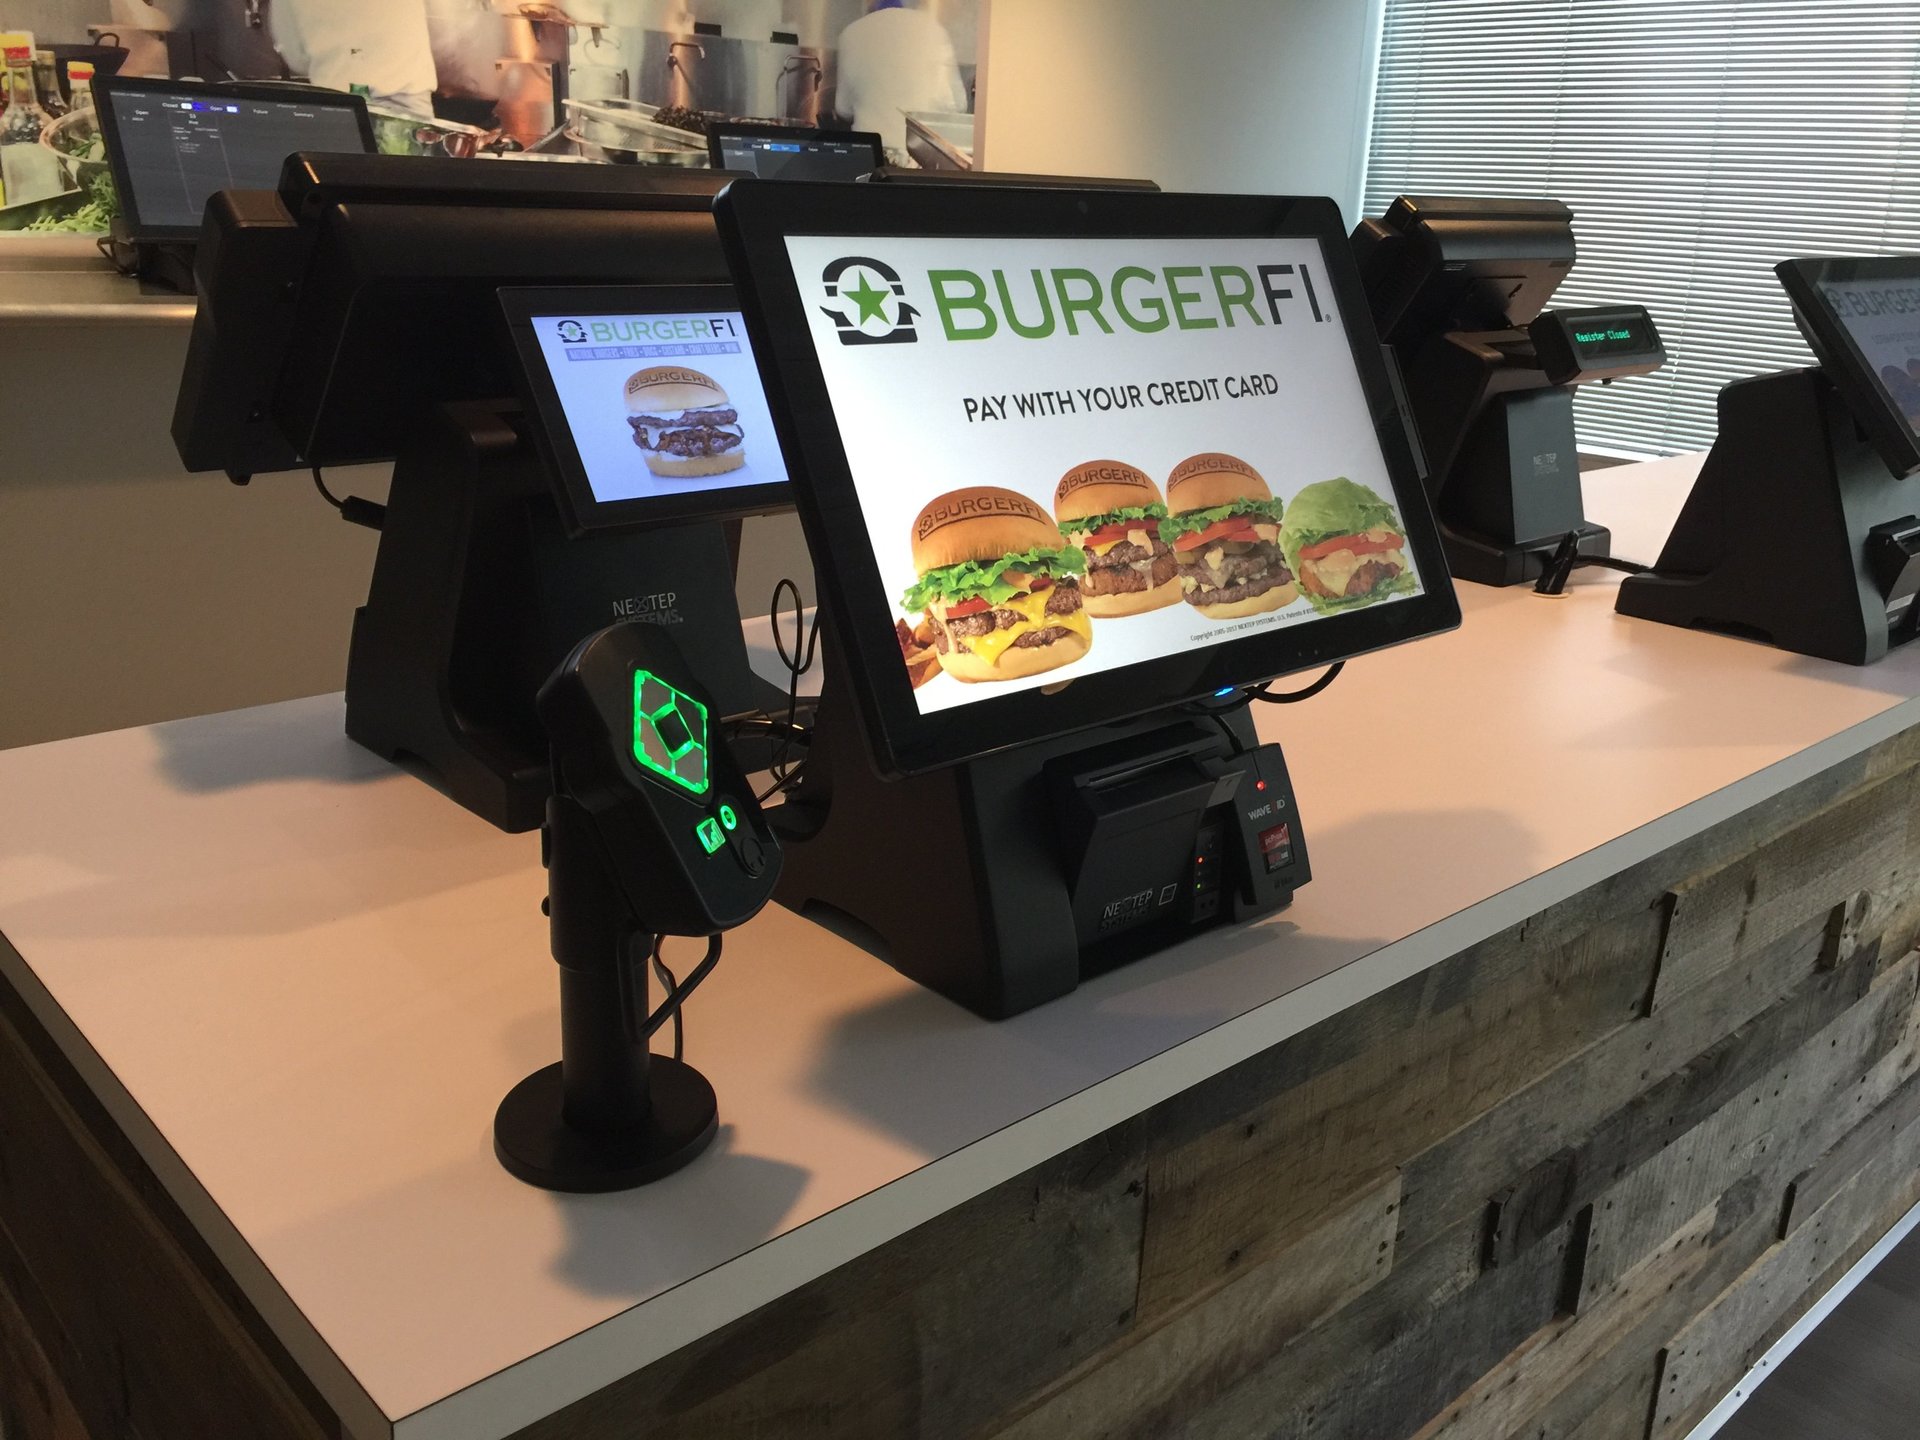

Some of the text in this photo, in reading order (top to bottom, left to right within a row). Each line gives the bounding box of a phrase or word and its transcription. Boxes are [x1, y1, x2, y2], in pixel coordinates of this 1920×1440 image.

[927, 263, 1324, 341] BURGERFI
[591, 318, 736, 342] BURGERFI
[1575, 329, 1630, 342] Register Closed
[963, 373, 1279, 423] PAY WITH YOUR CREDIT CARD
[1068, 468, 1146, 488] BURGERFI
[1179, 459, 1255, 478] BURGERFI
[934, 497, 1041, 522] BURGERFI
[1190, 630, 1214, 641] Copyright
[1248, 799, 1286, 820] WAVE ID
